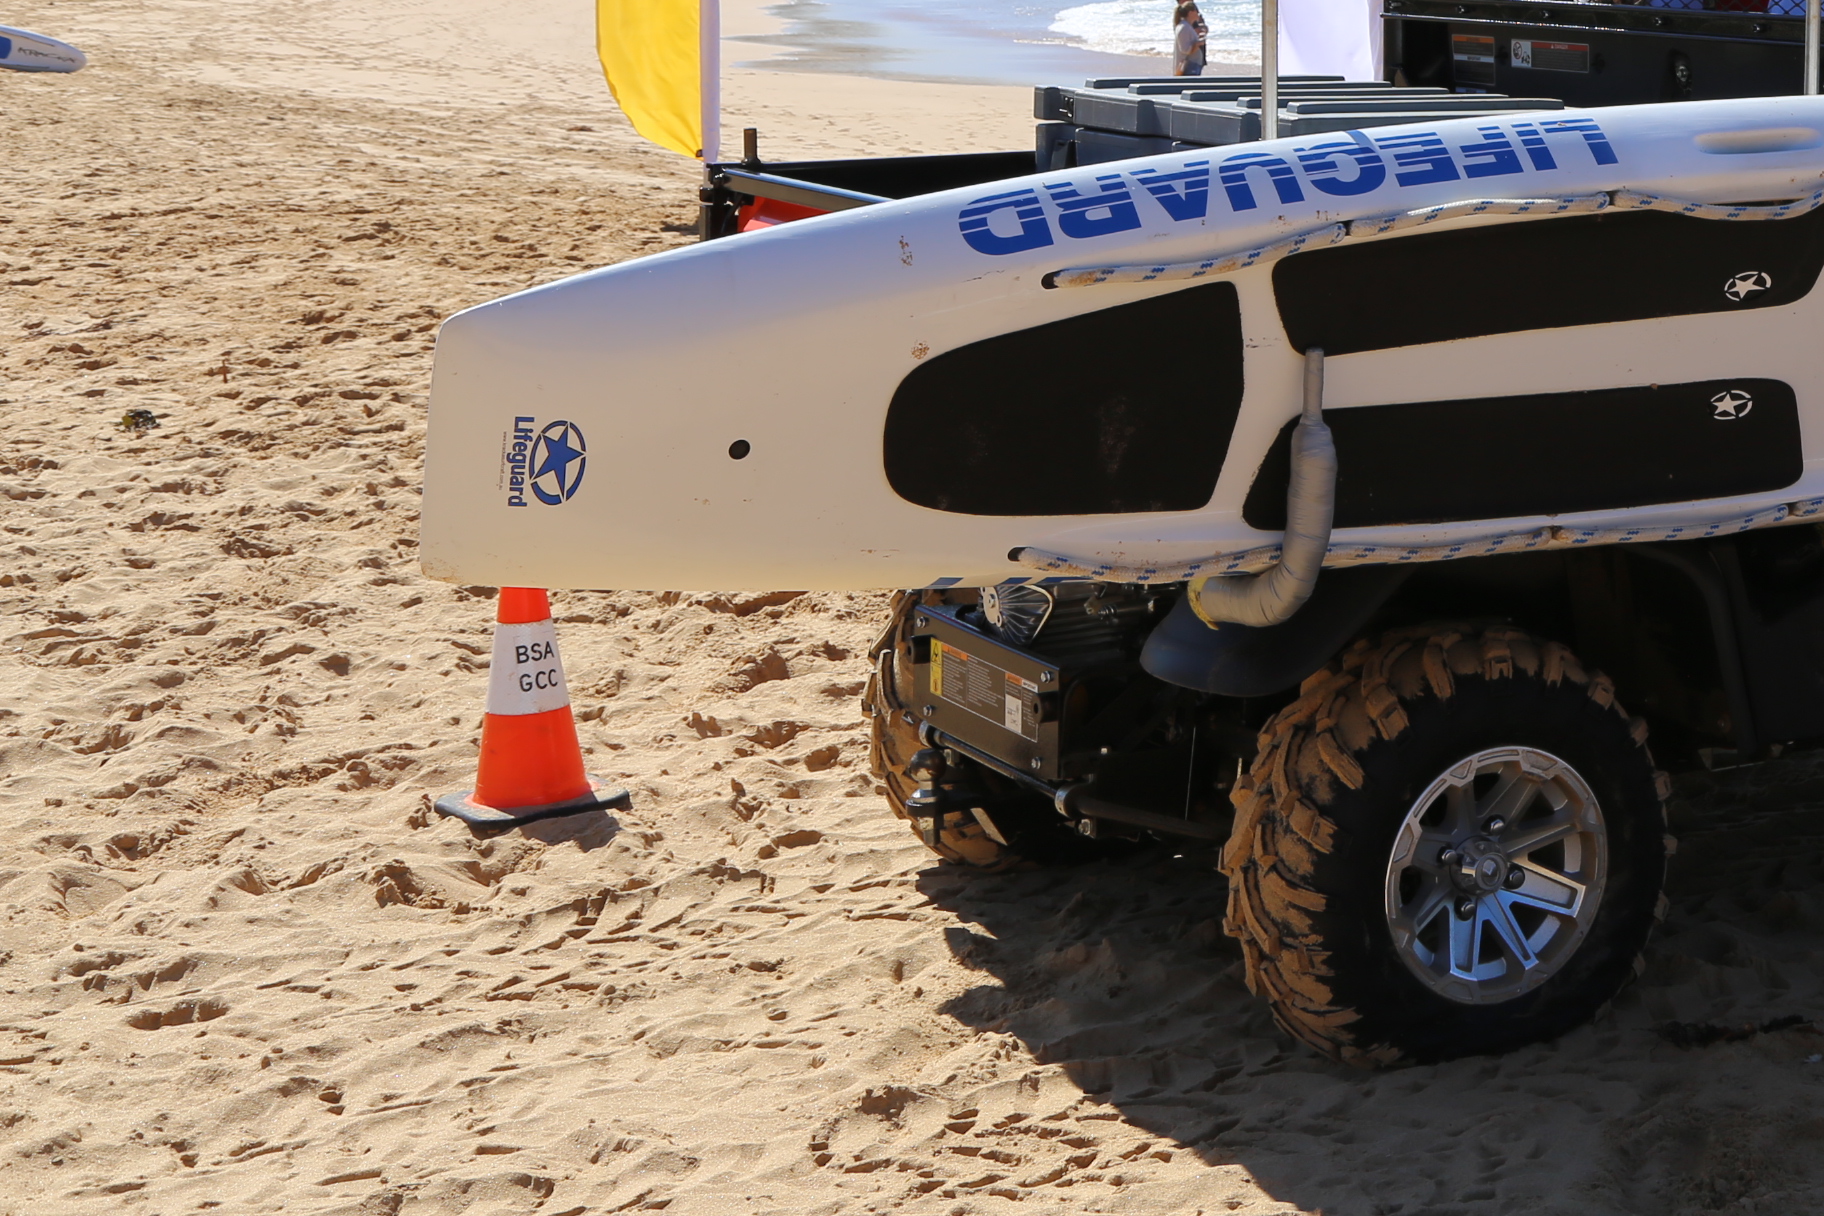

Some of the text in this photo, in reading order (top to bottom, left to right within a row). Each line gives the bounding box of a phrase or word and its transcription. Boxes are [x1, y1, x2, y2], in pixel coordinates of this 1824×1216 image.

[957, 115, 1619, 257] LIFEGUARD
[507, 416, 535, 507] Lifeguard
[515, 642, 555, 666] BSA
[518, 669, 559, 693] GCC
